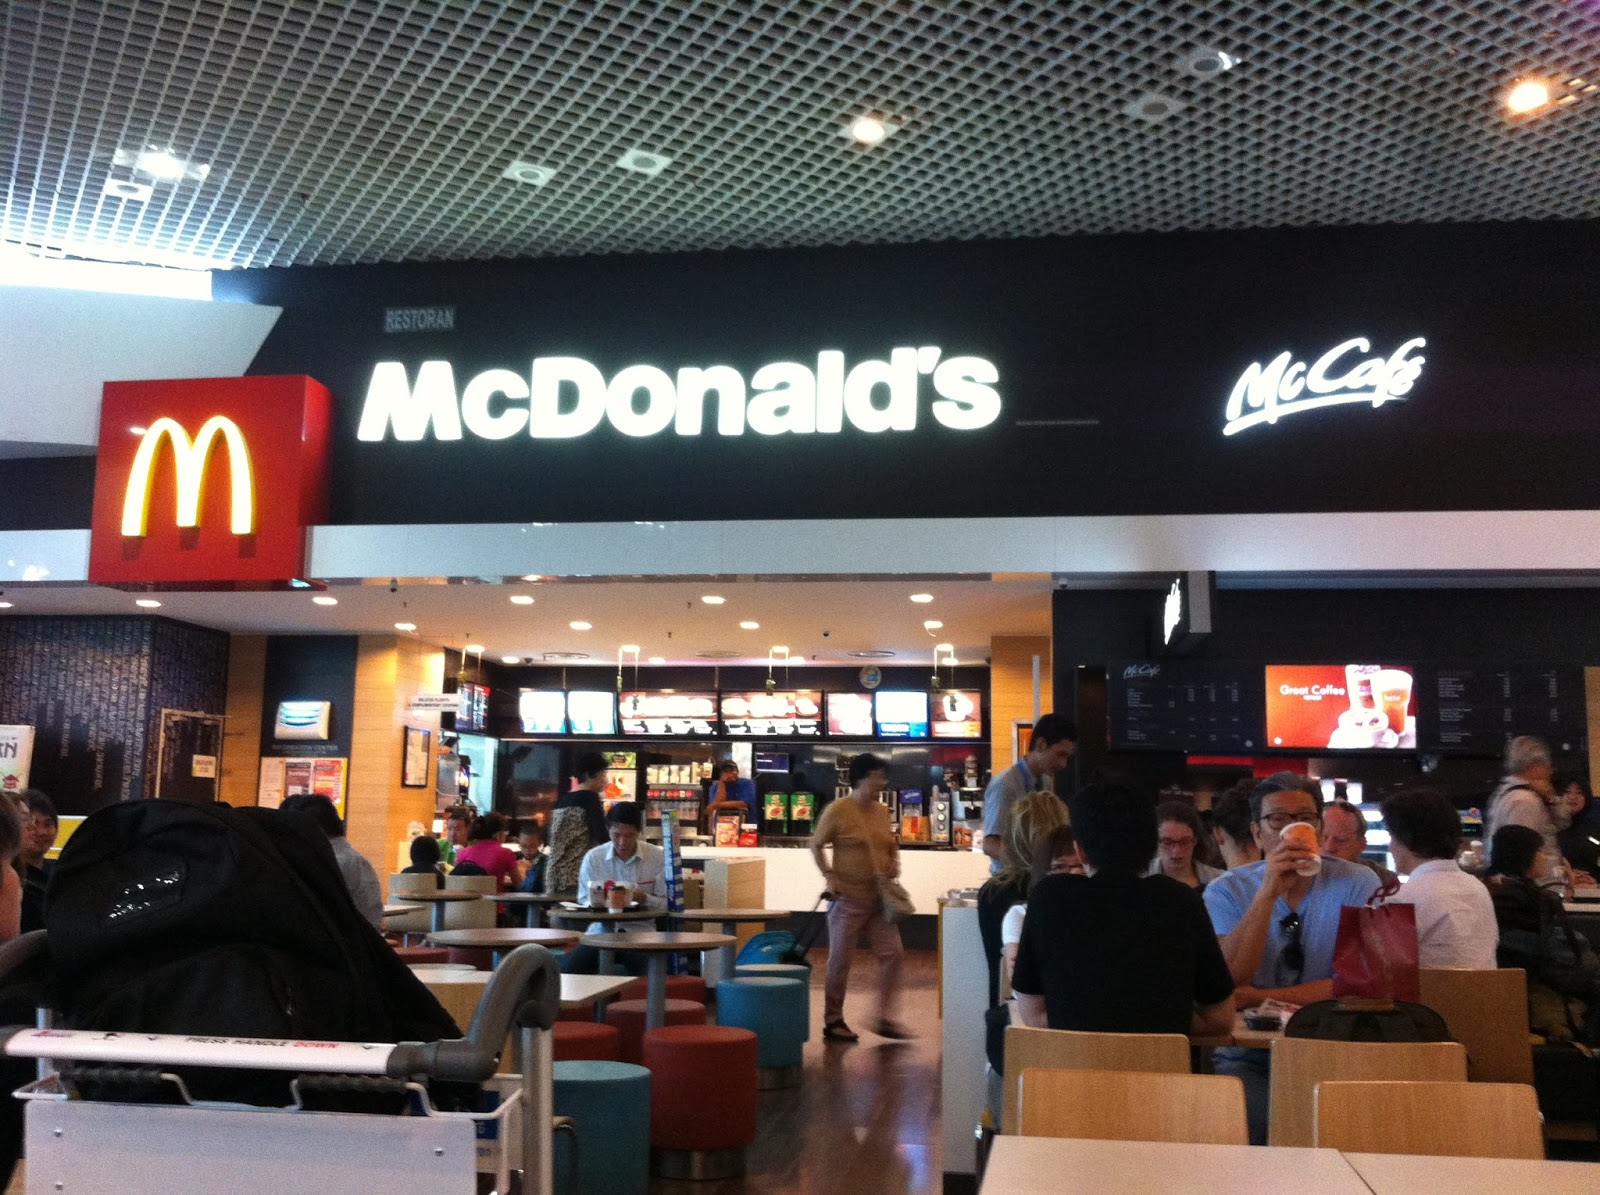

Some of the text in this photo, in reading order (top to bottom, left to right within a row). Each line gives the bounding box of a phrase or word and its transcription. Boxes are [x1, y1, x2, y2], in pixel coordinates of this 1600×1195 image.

[385, 308, 455, 332] RESTORAN
[357, 347, 1001, 442] McDonald's
[1280, 684, 1346, 696] Great Coffee
